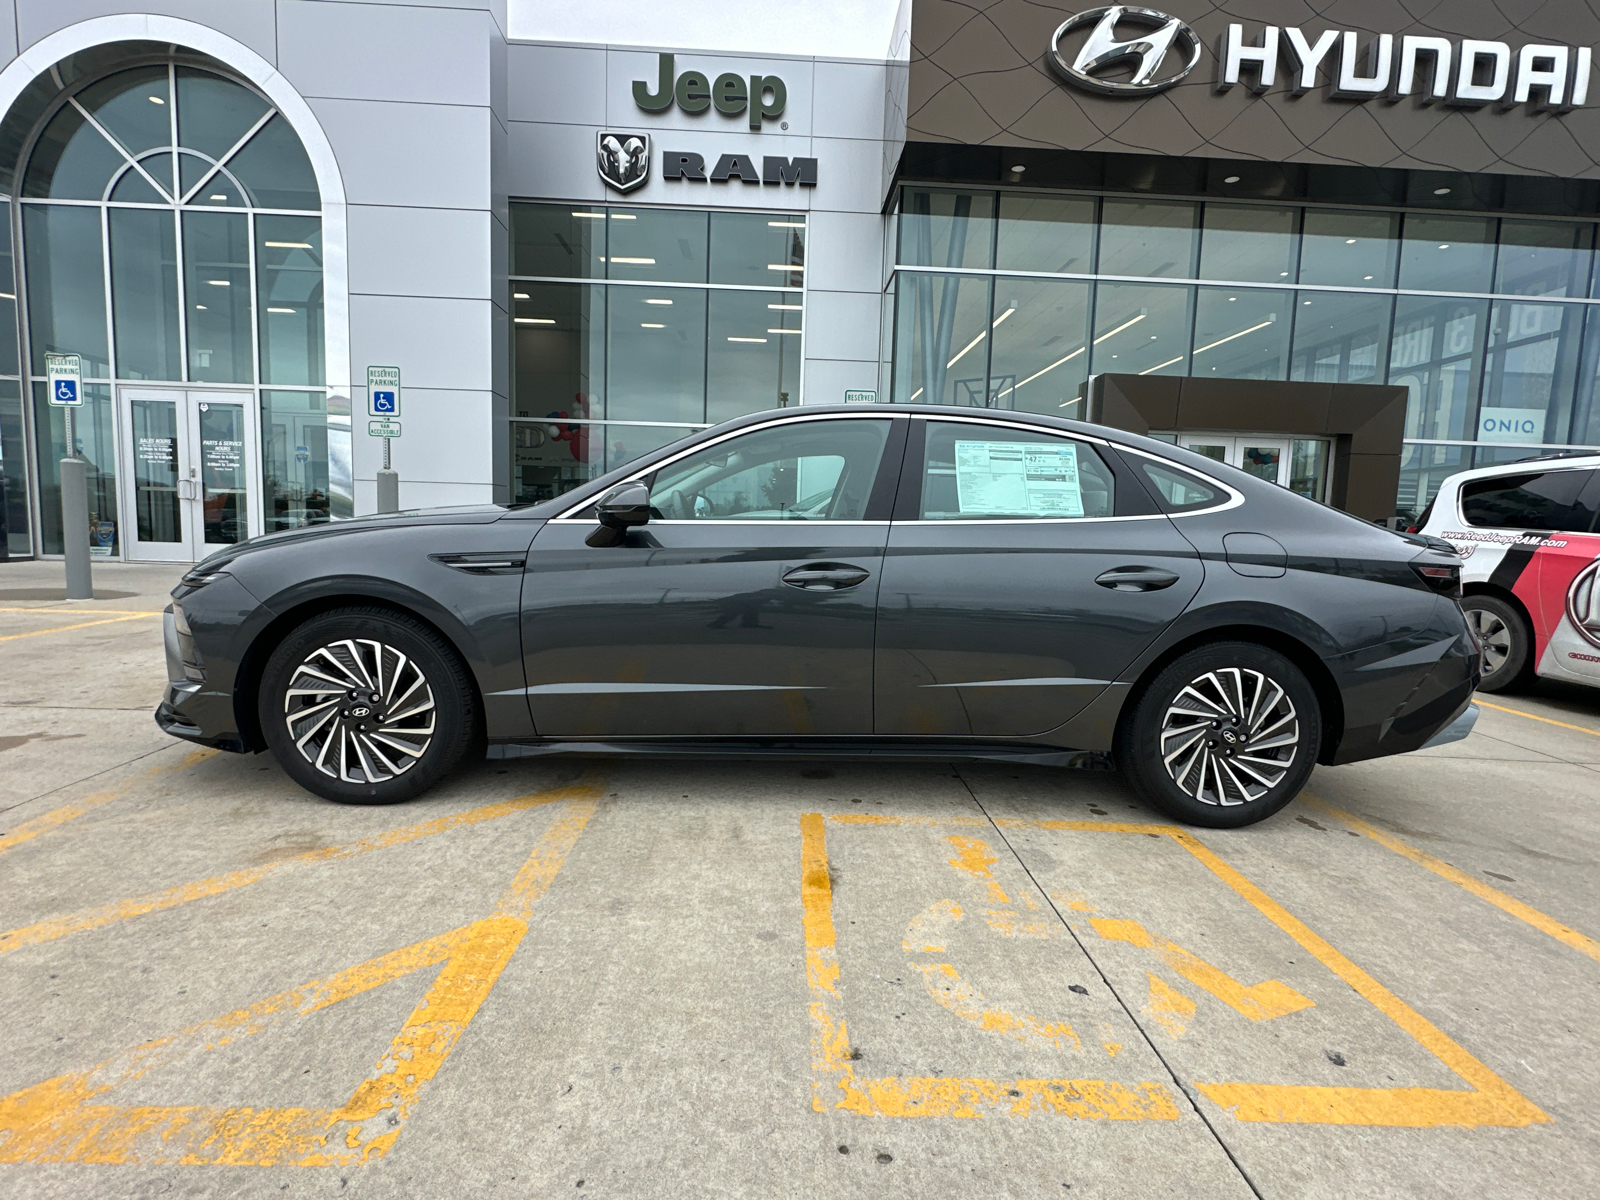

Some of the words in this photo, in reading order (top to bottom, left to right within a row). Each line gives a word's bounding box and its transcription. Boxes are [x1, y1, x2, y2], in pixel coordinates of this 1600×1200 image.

[1218, 22, 1592, 110] HYUNDAI
[632, 53, 787, 130] Jeep
[662, 151, 819, 187] RAM
[50, 358, 78, 366] RESERVED
[50, 367, 79, 375] PARKING
[848, 394, 874, 402] RESERVED
[1441, 531, 1568, 548] www.ReedJeepRAM.com
